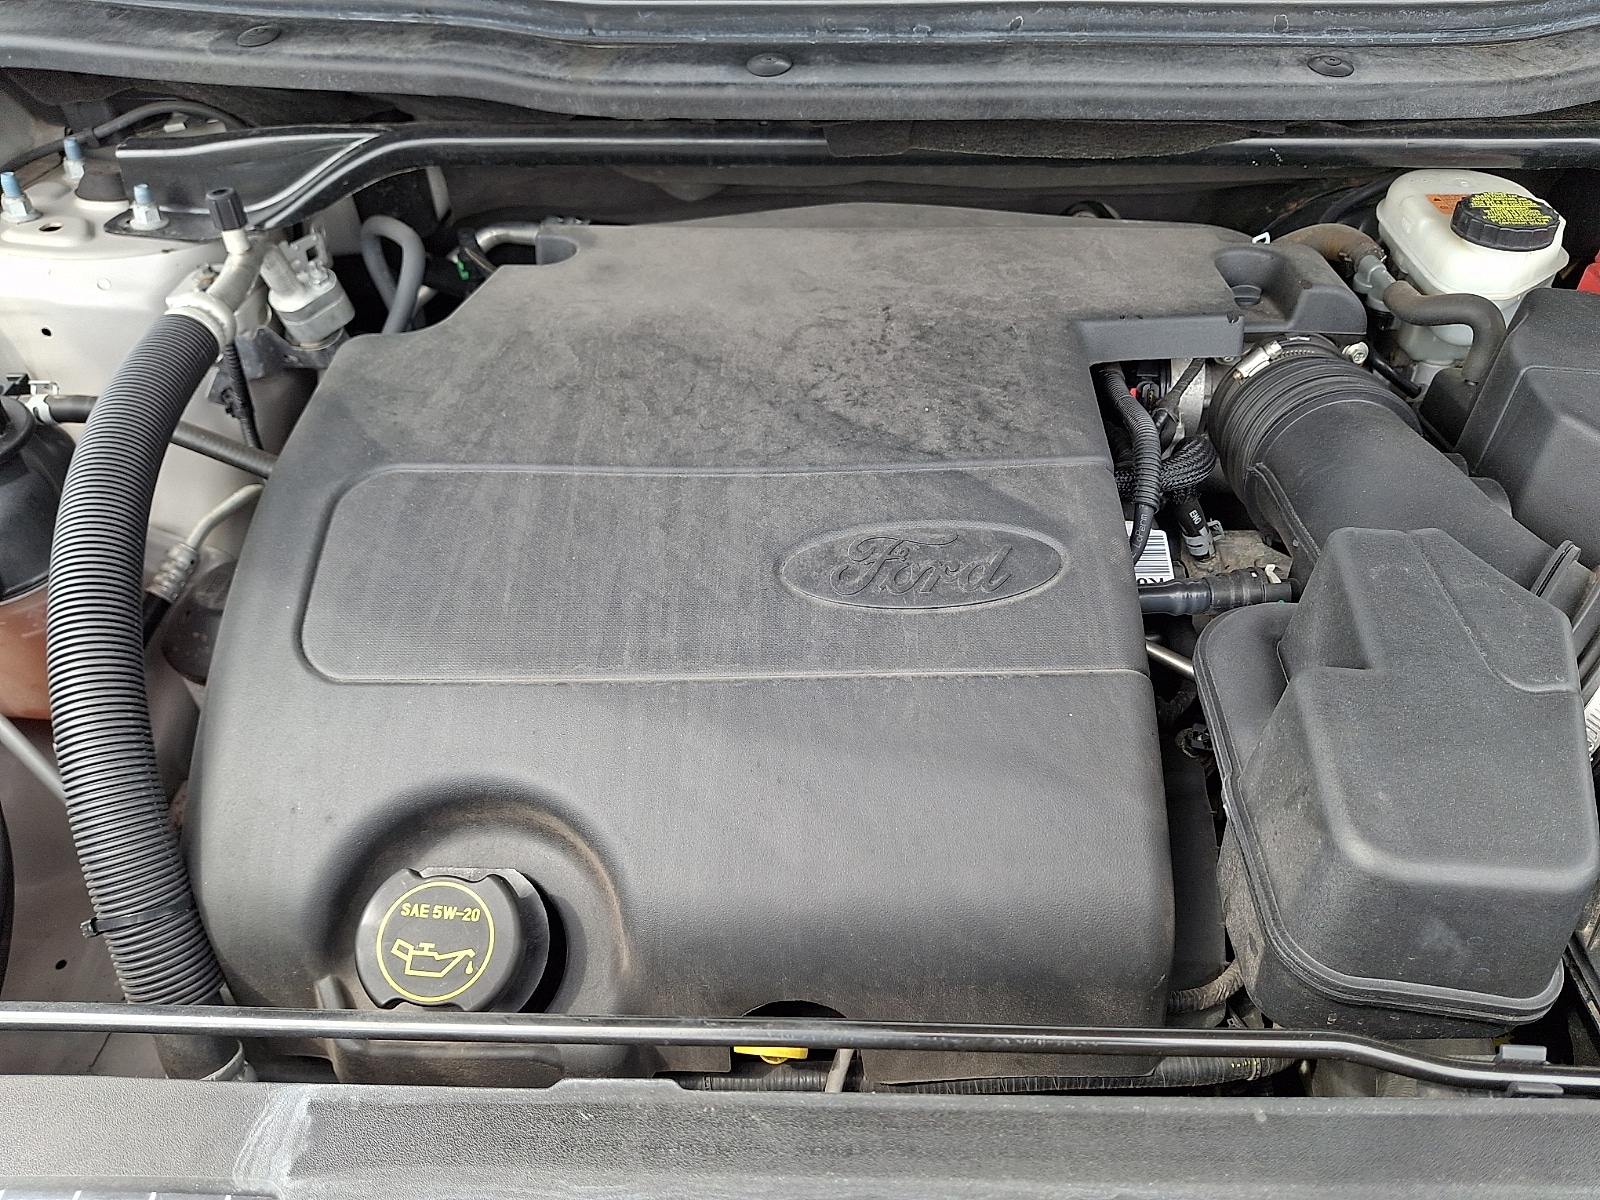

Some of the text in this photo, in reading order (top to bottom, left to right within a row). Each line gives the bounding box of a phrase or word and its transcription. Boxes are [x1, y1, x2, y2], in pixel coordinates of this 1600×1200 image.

[830, 533, 1014, 596] Ford
[400, 902, 481, 922] SAE 5W-20
